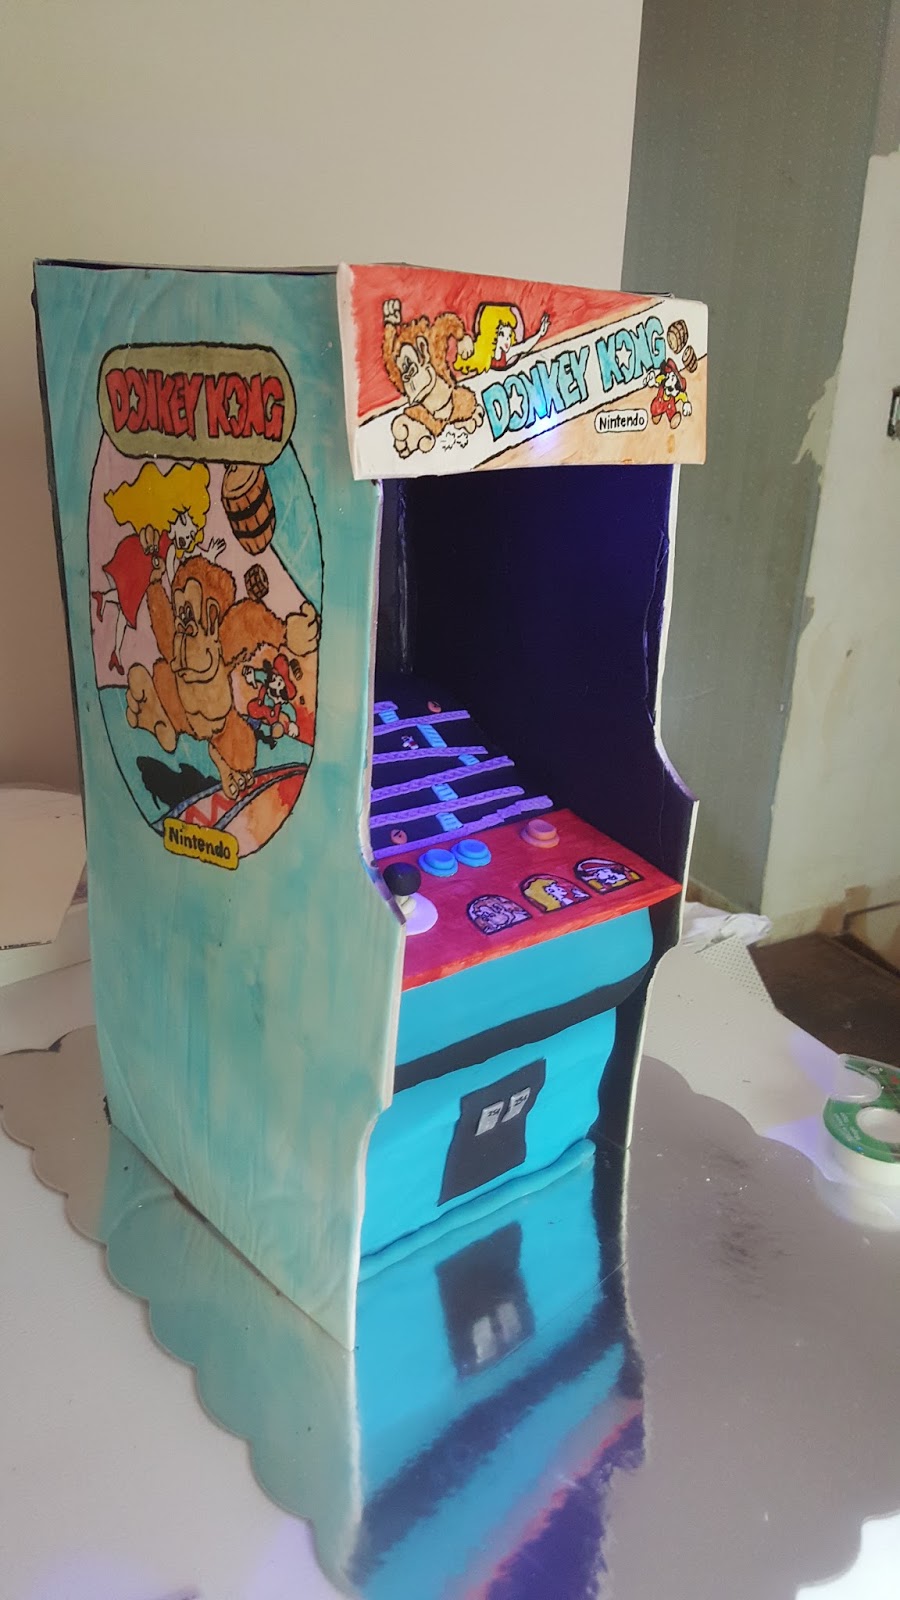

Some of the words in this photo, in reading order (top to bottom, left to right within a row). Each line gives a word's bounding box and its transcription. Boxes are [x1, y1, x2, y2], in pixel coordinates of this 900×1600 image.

[105, 367, 204, 441] DONKEY
[205, 372, 285, 442] KONG
[481, 346, 590, 442] DONKEY
[595, 316, 667, 393] KONG
[599, 412, 645, 431] Nintendo
[168, 825, 231, 860] Nintendo
